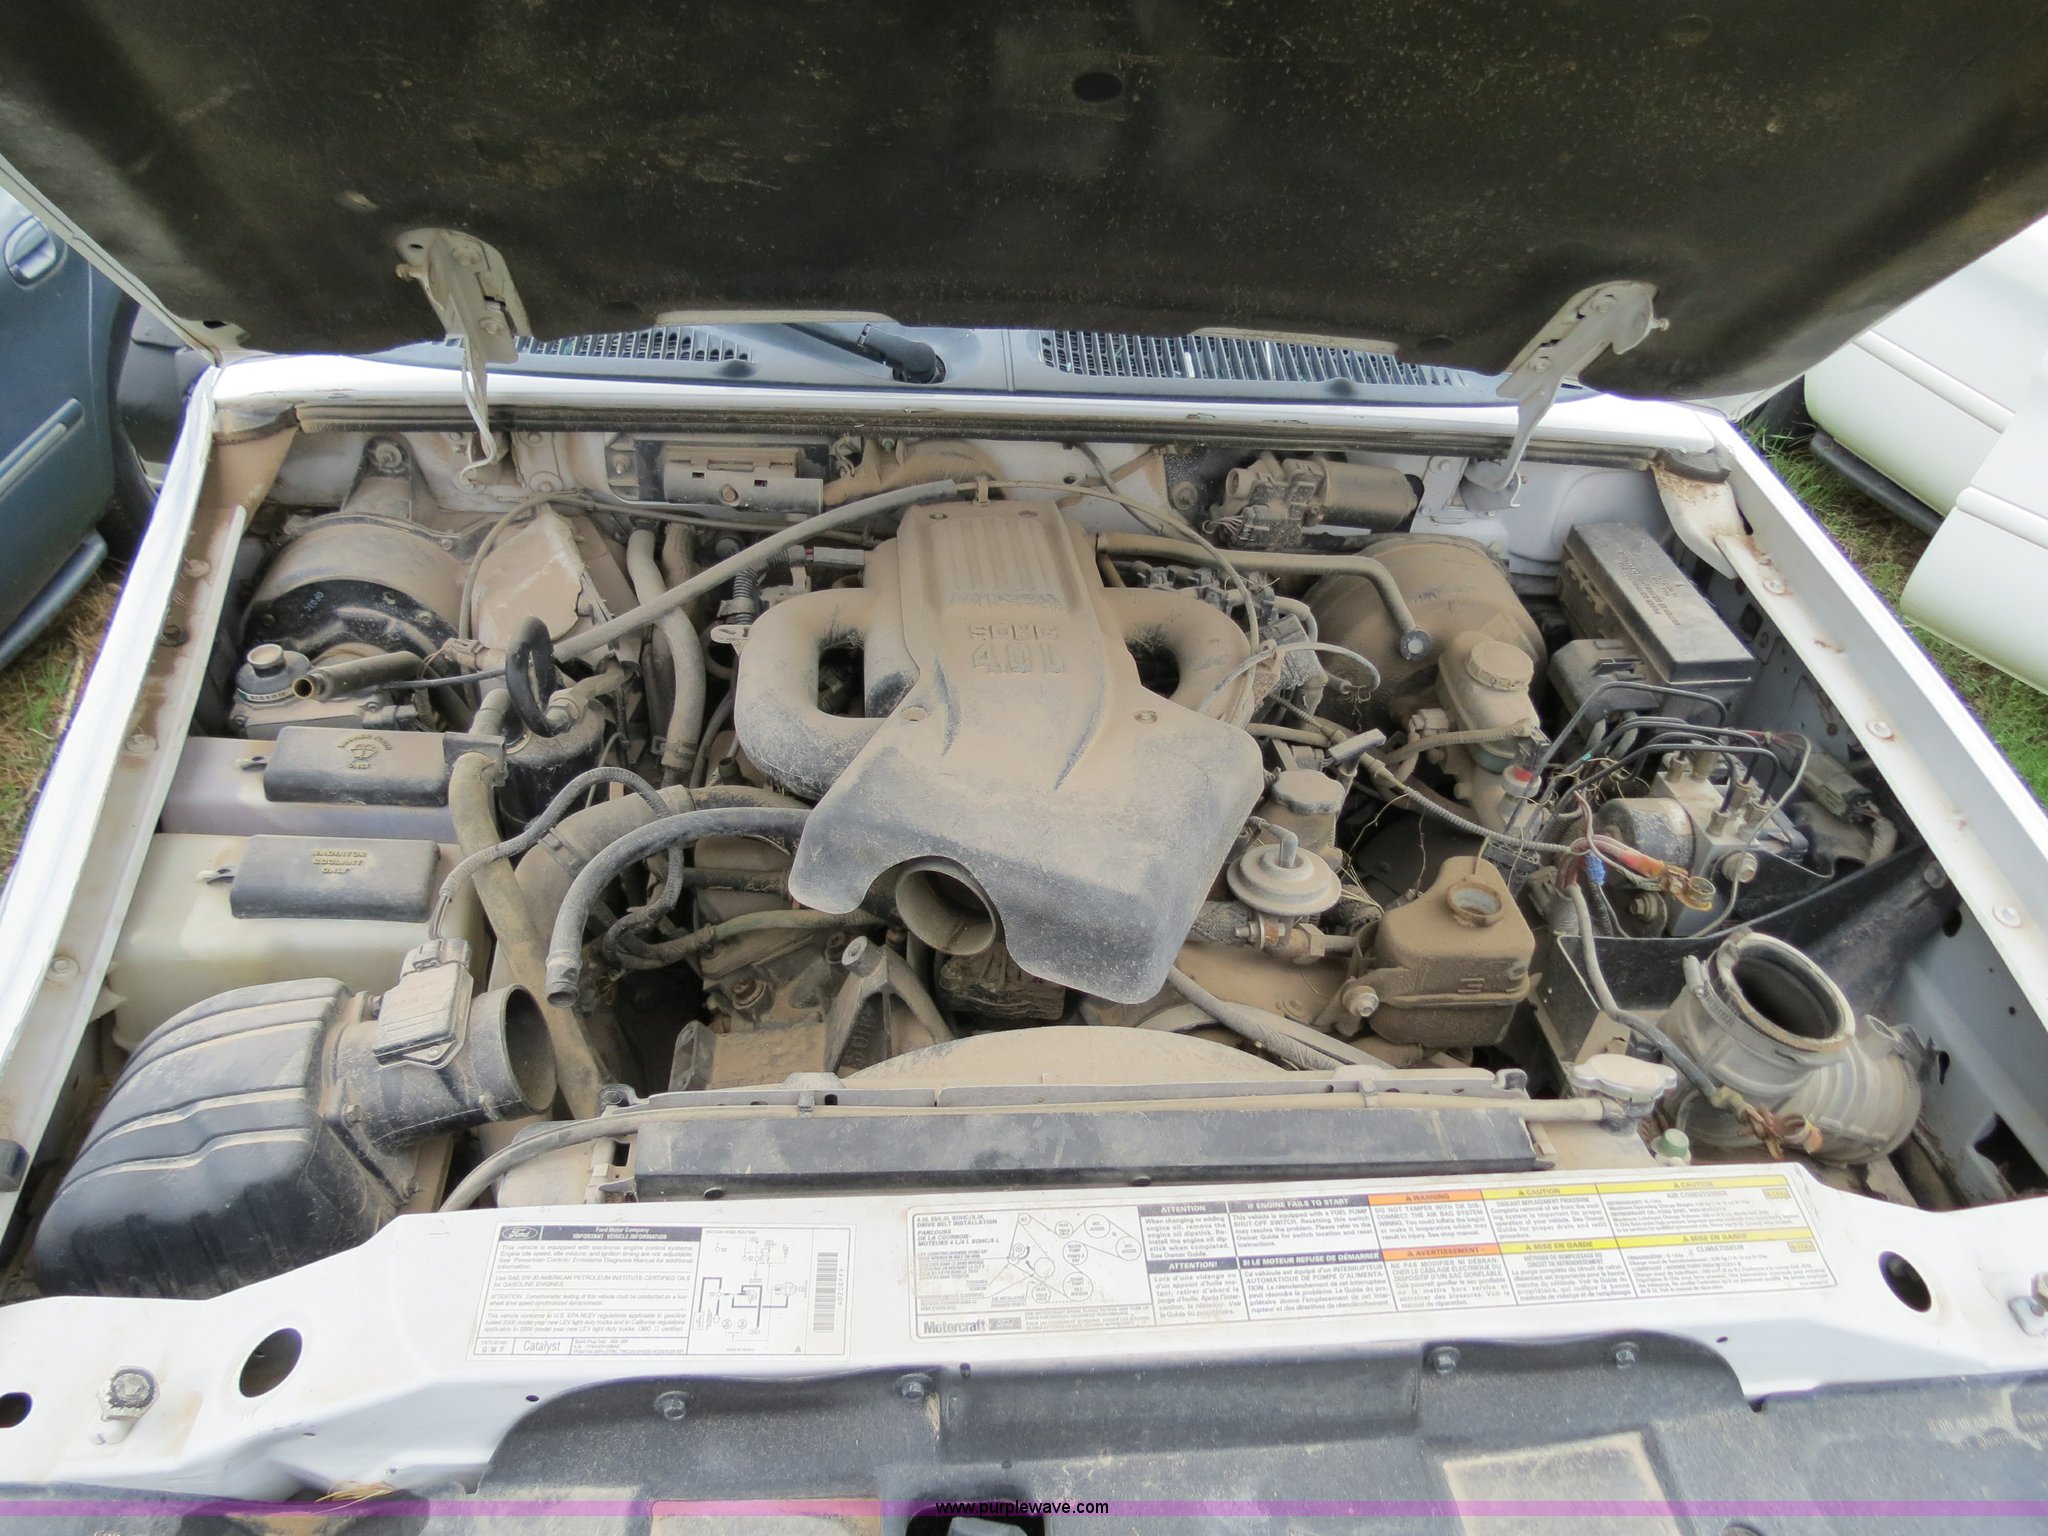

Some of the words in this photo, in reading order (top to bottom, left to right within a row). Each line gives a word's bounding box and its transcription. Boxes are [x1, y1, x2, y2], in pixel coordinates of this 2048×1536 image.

[969, 624, 1058, 640] SOHC
[1526, 1187, 1560, 1196] CAUTION
[1412, 1193, 1450, 1201] WARNING
[1288, 1200, 1310, 1208] FAILS
[1312, 1199, 1322, 1207] TO
[1324, 1198, 1349, 1206] START
[1161, 1205, 1206, 1214] ATTENTION
[1416, 1247, 1479, 1257] AVERTISSEMENT
[1242, 1259, 1250, 1267] SI
[1262, 1257, 1294, 1265] MOTEUR
[1337, 1252, 1379, 1261] DÉMARRER
[1168, 1261, 1218, 1271] ATTENTION!
[924, 1319, 986, 1334] Motorcraft
[523, 1339, 561, 1354] Catalyst
